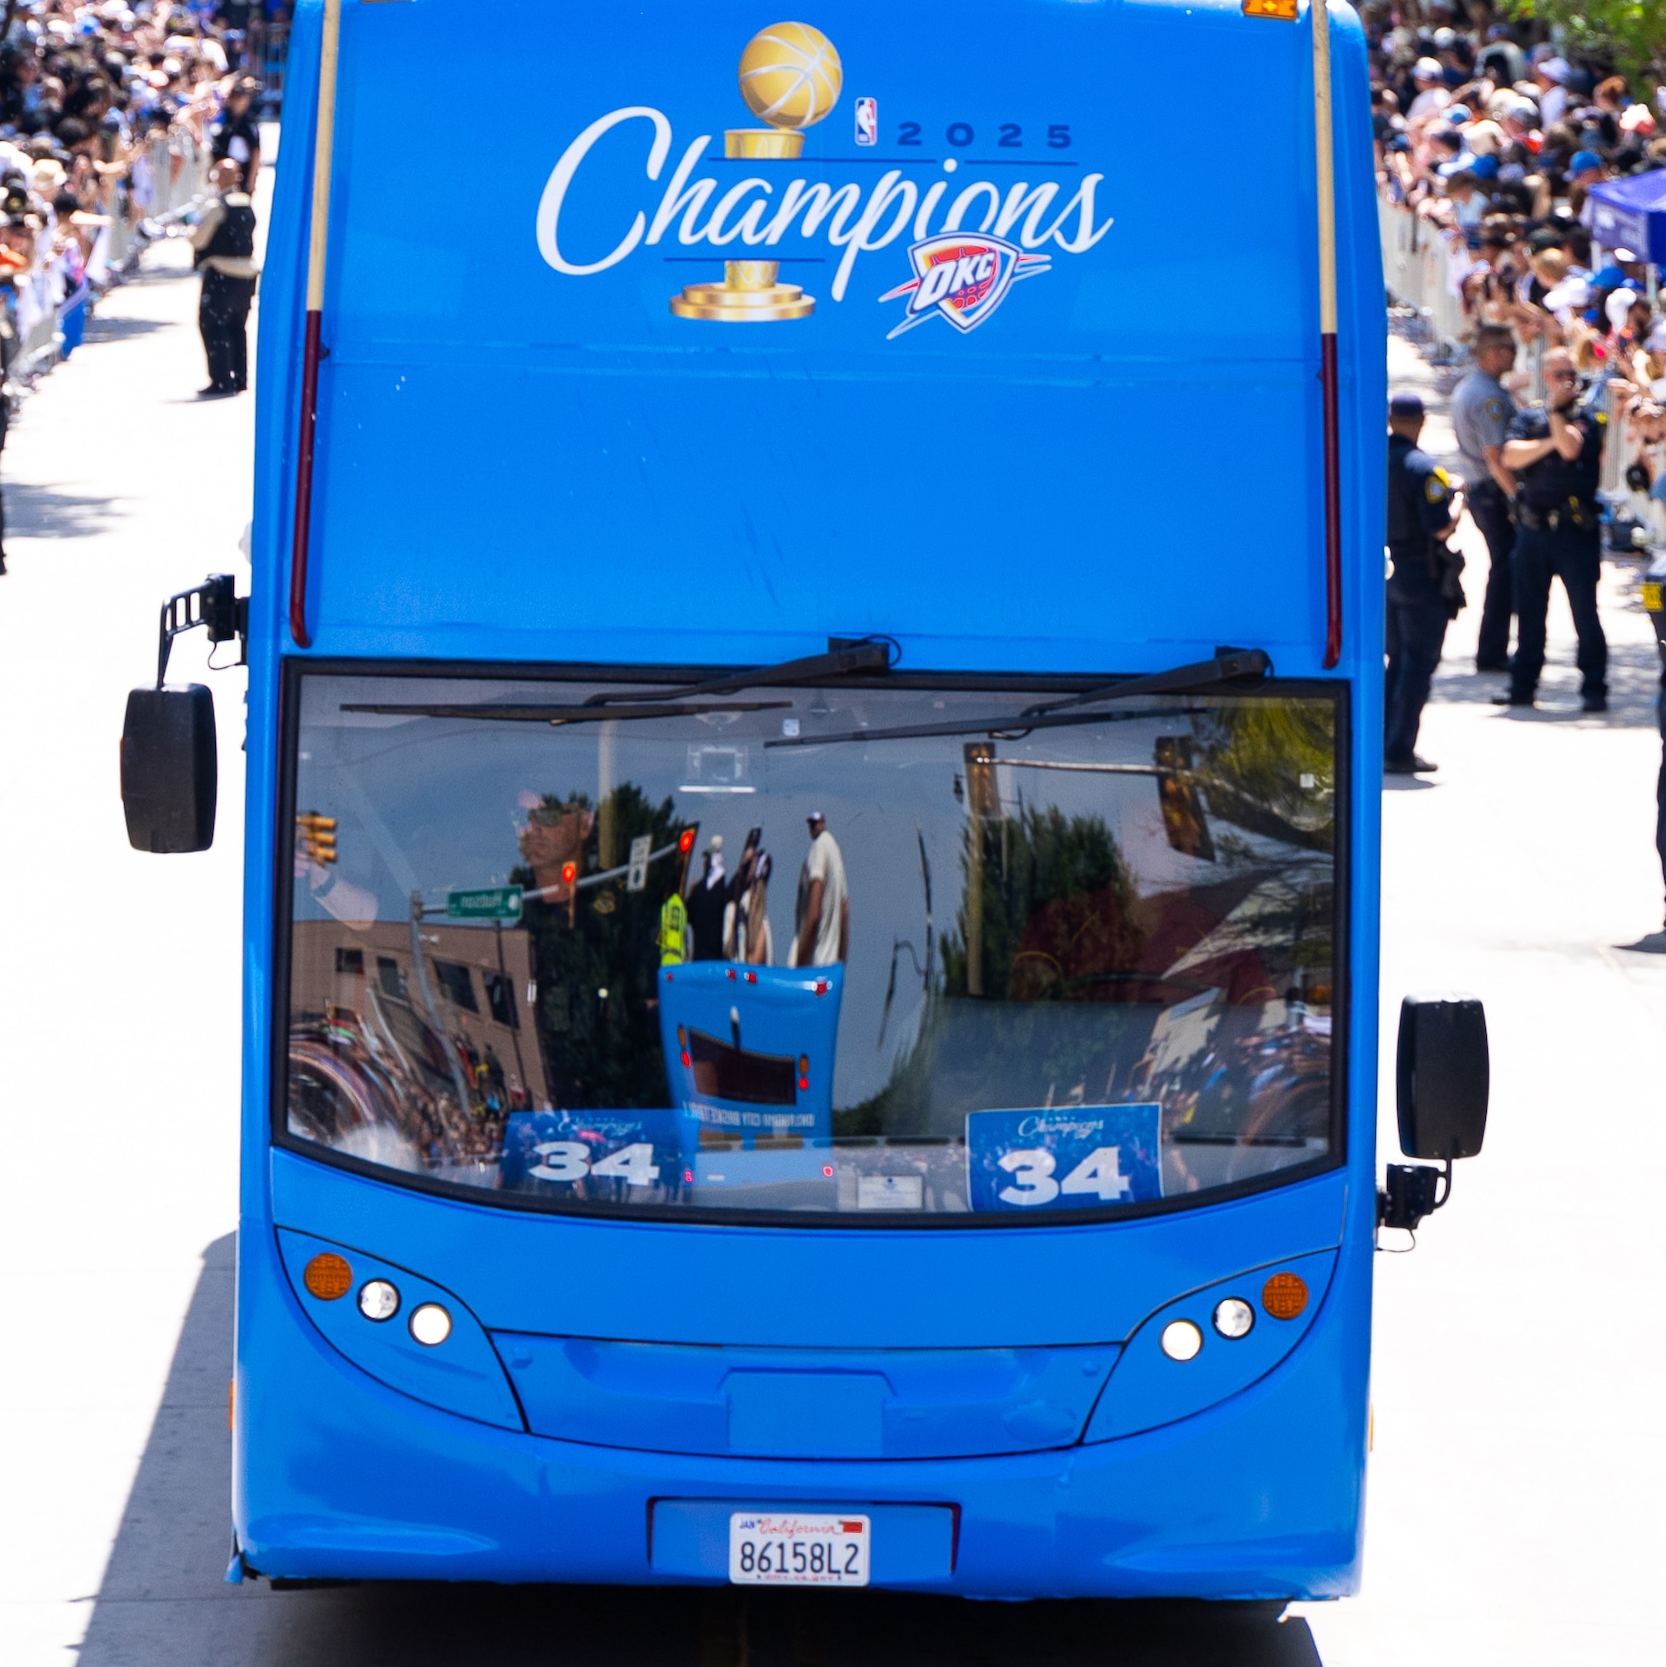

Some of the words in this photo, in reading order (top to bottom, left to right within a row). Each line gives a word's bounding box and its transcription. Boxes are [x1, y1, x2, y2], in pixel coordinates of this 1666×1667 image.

[897, 121, 1072, 149] 2025
[536, 106, 1114, 301] Champions
[913, 252, 995, 310] OKC
[528, 1140, 660, 1186] 34
[997, 1145, 1130, 1206] 34
[739, 1520, 755, 1530] JAN
[758, 1517, 844, 1539] California
[740, 1541, 859, 1575] 86158L2
